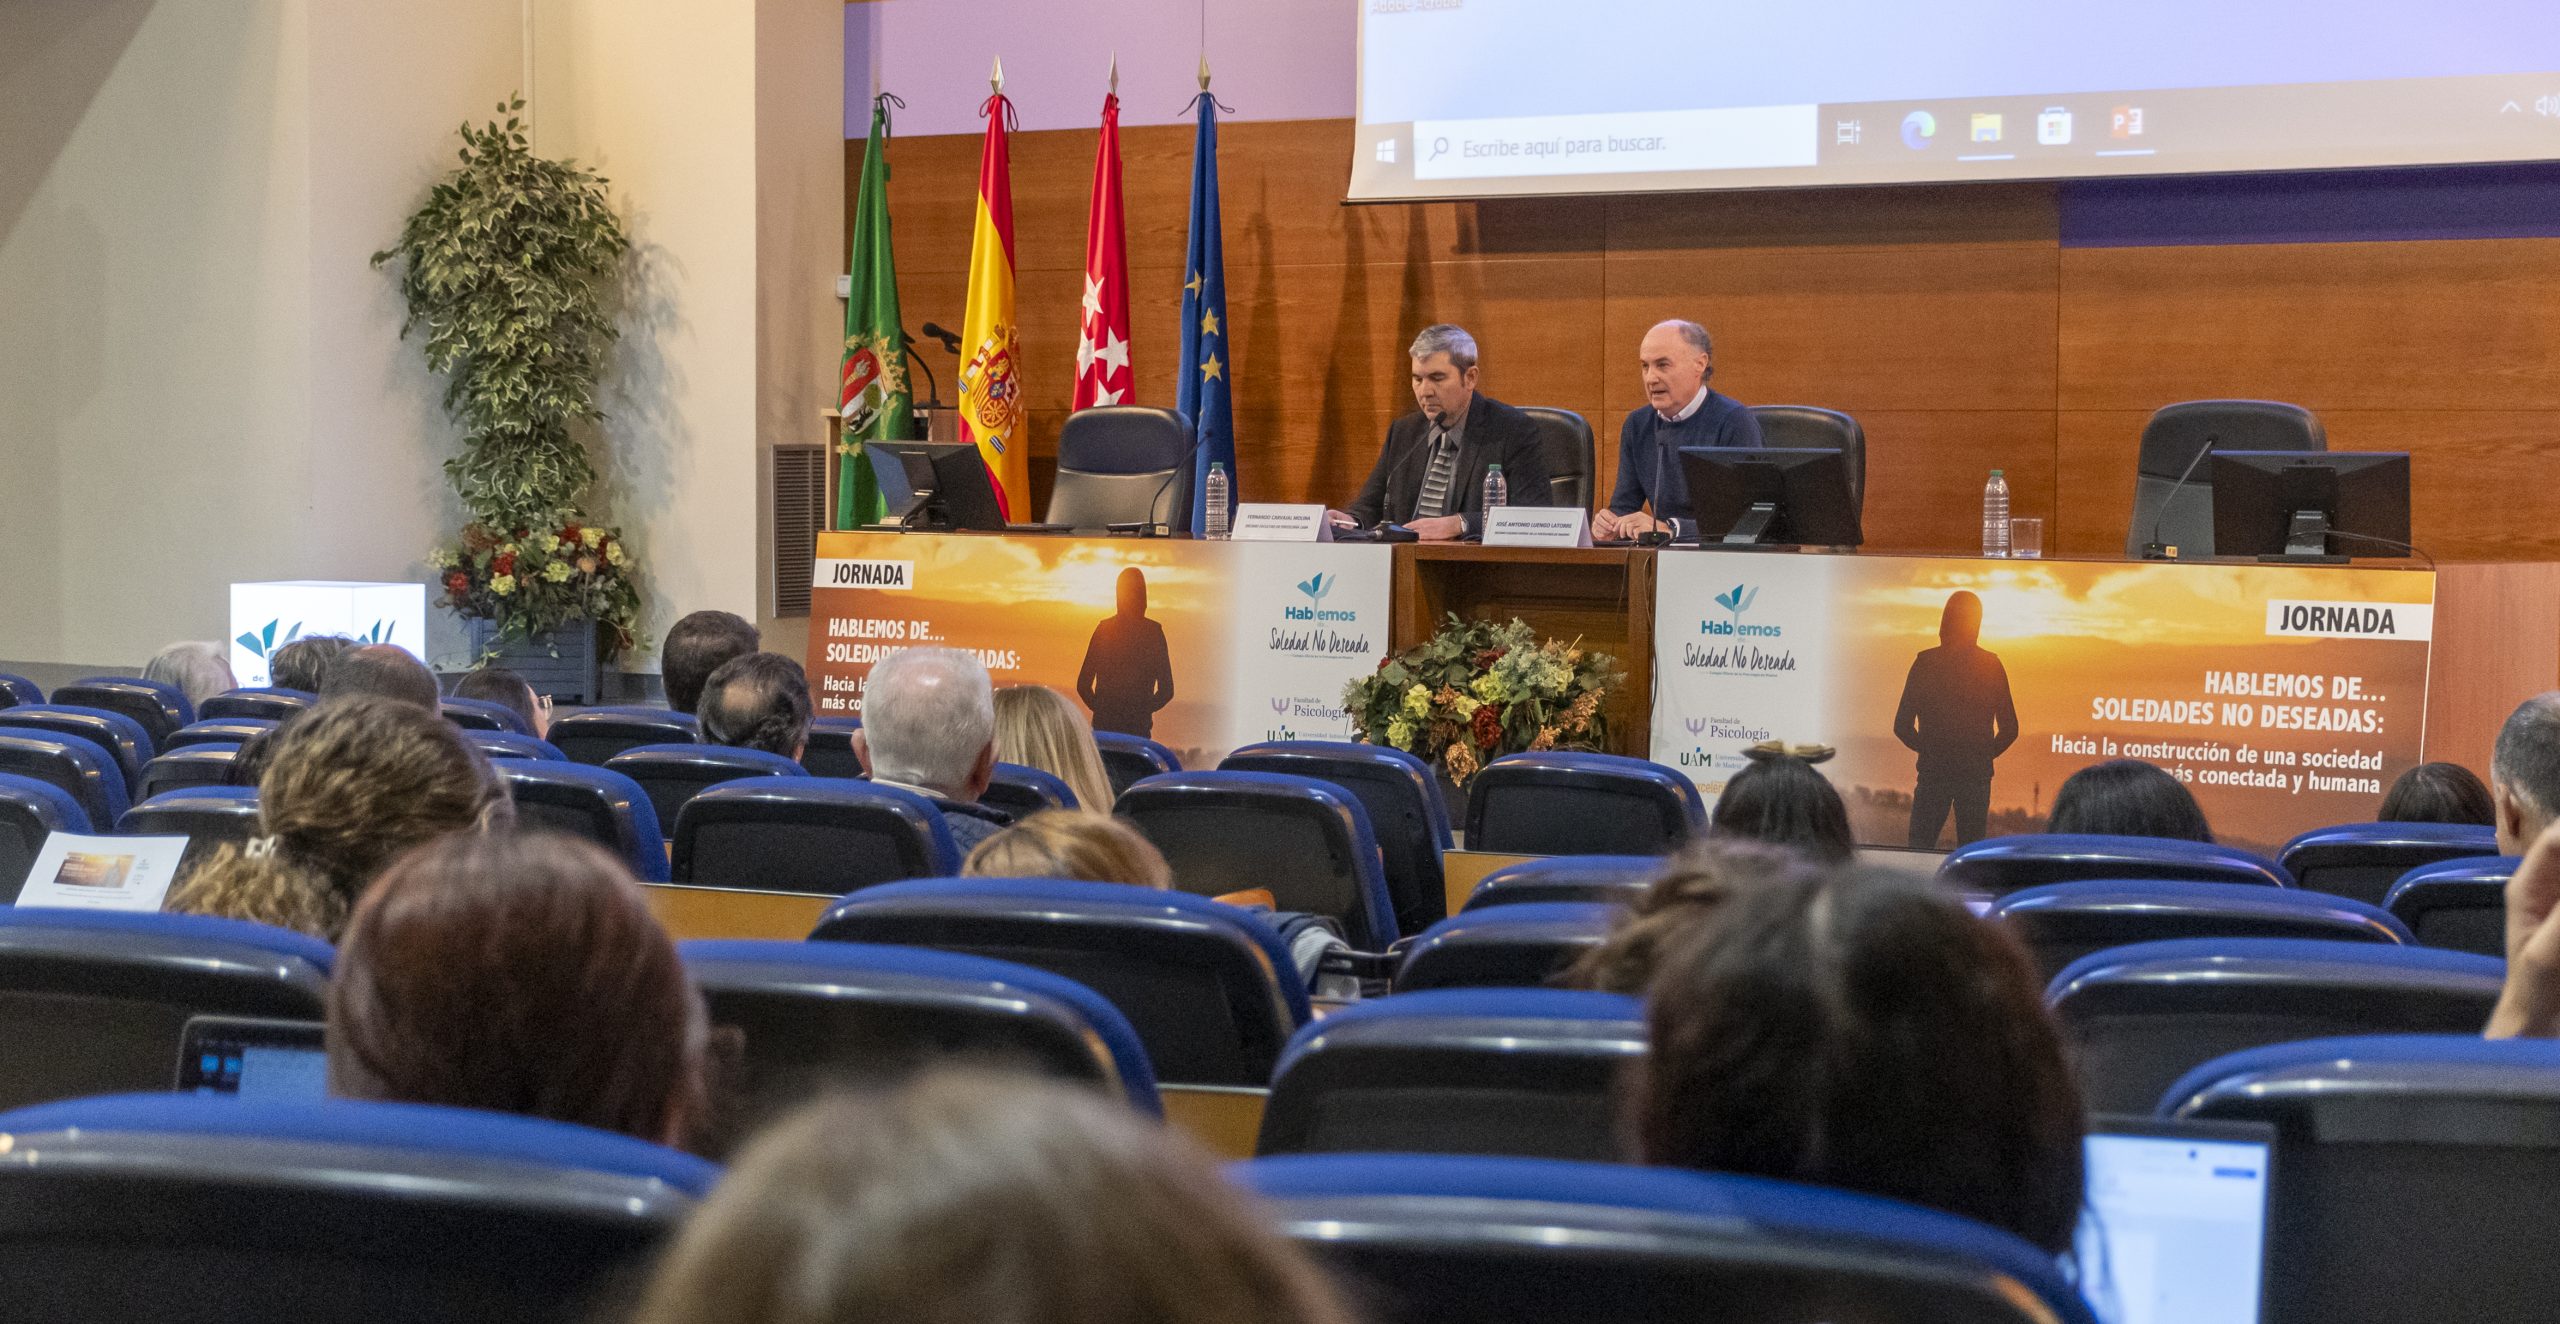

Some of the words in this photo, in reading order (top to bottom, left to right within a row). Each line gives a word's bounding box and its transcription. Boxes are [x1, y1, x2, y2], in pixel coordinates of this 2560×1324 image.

[1463, 139, 1520, 158] Escribe
[1524, 137, 1561, 158] aquí
[1565, 138, 1602, 157] para
[1607, 134, 1667, 152] buscar.
[833, 563, 904, 585] JORNADA
[829, 618, 905, 639] HABLEMOS
[910, 621, 945, 641] DE...
[2280, 605, 2396, 634] JORNADA
[1269, 627, 1309, 651] Soledad
[1312, 629, 1326, 652] No
[1329, 630, 1370, 654] Deseada
[826, 643, 908, 663] SOLEDAD
[1683, 642, 1728, 668] Soledad
[1731, 645, 1747, 669] No
[1750, 646, 1796, 671] Deseada
[824, 675, 855, 691] Hacia
[2204, 671, 2323, 699] HABLEMOS
[2331, 676, 2386, 702] DE...
[822, 694, 845, 710] más
[2091, 697, 2214, 725] SOLEDADES
[2221, 702, 2253, 727] NO
[2260, 705, 2385, 734] DESEADAS:
[1267, 729, 1296, 742] UAM
[1710, 725, 1770, 742] Psicología
[1680, 751, 1712, 767] UAM
[2051, 734, 2097, 756] Hacia
[2102, 737, 2117, 757] la
[2123, 739, 2230, 763] construcción
[2236, 744, 2258, 764] de
[2263, 750, 2296, 766] una
[2301, 748, 2383, 771] sociedad
[2199, 768, 2287, 789] conectada
[2291, 773, 2304, 795] y
[2308, 770, 2381, 794] humana
